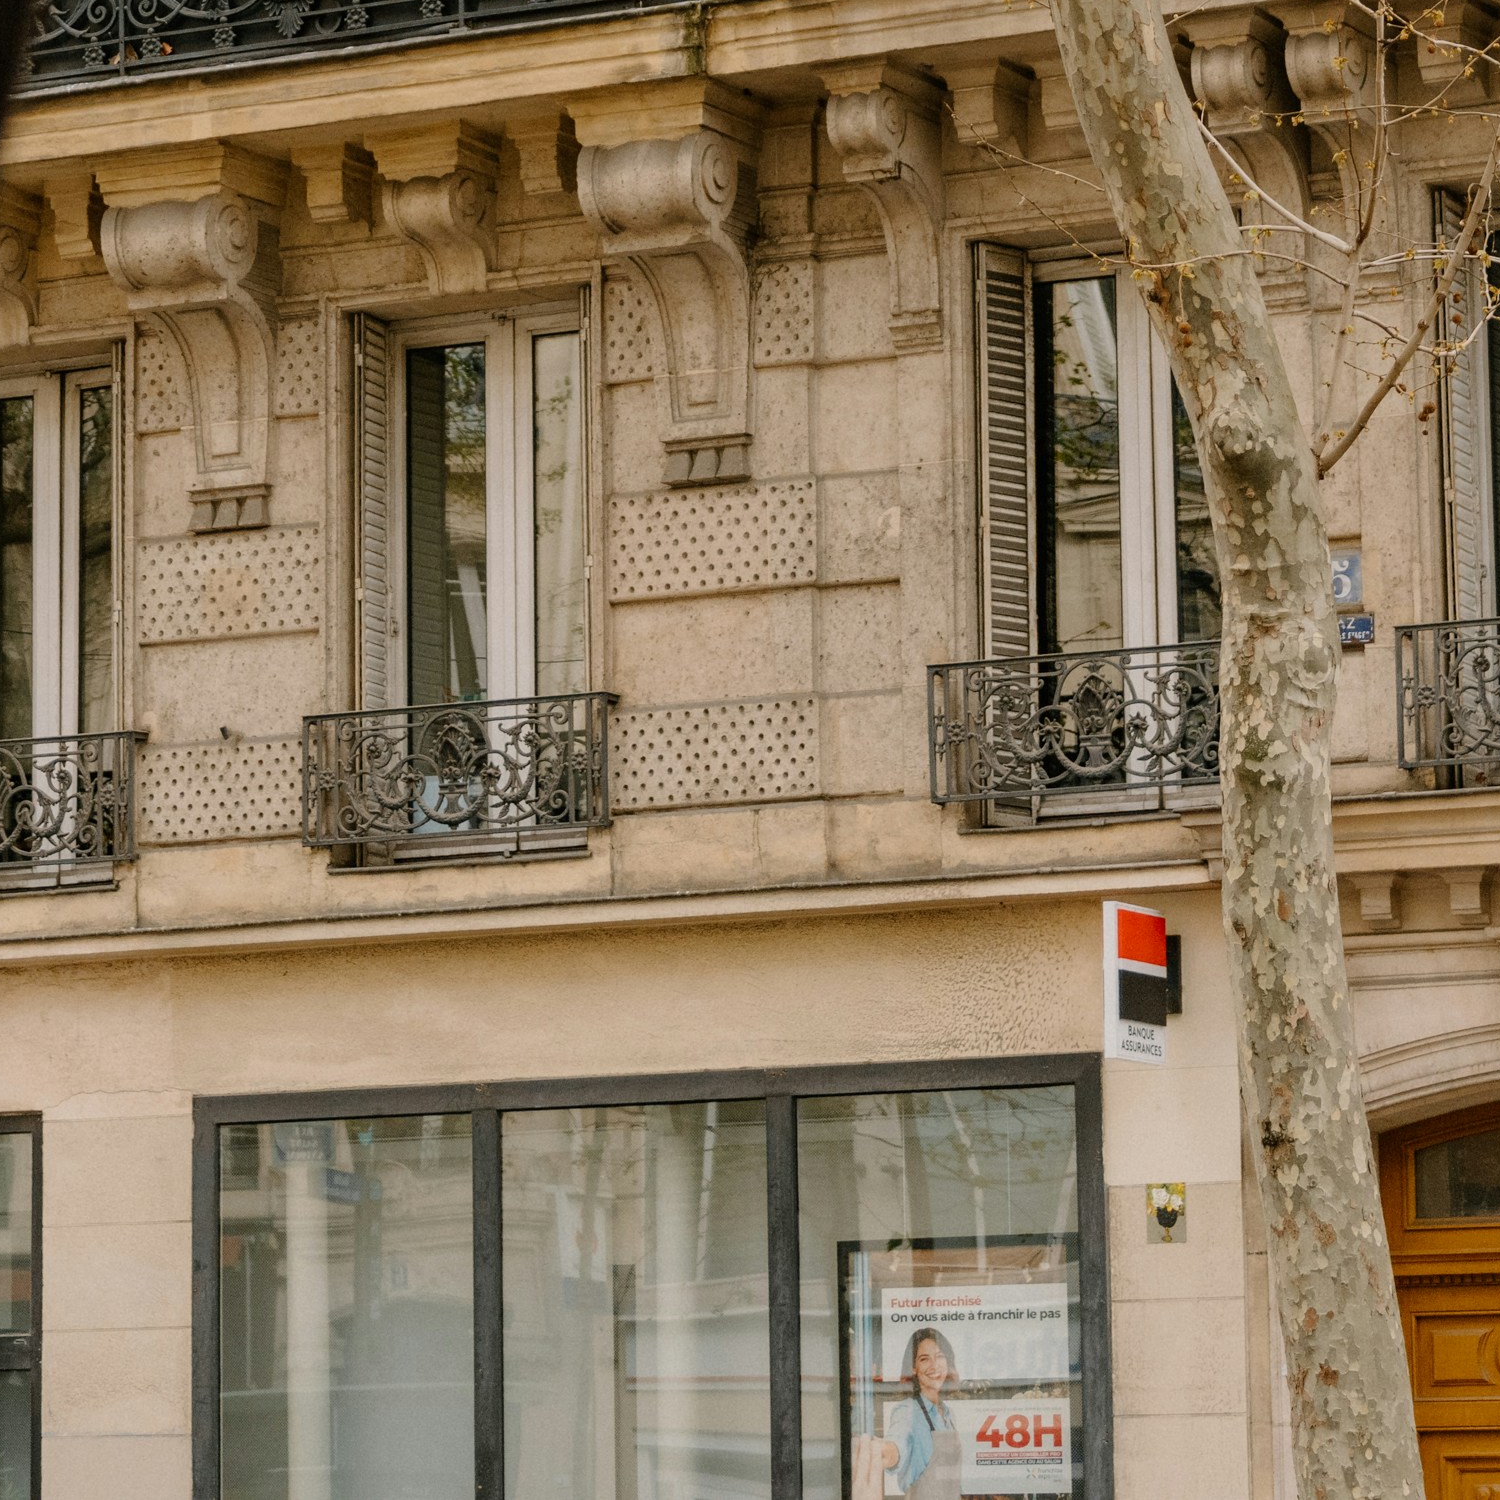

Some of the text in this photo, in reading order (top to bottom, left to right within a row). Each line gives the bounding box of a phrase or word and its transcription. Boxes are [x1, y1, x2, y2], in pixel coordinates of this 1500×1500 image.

[1128, 1025, 1155, 1040] BANQUE
[1121, 1039, 1162, 1056] ASSURANCES
[890, 1295, 982, 1309] Futur franchisé
[890, 1308, 1061, 1323] On vous aide à franchir le pas
[975, 1414, 1062, 1448] 48H
